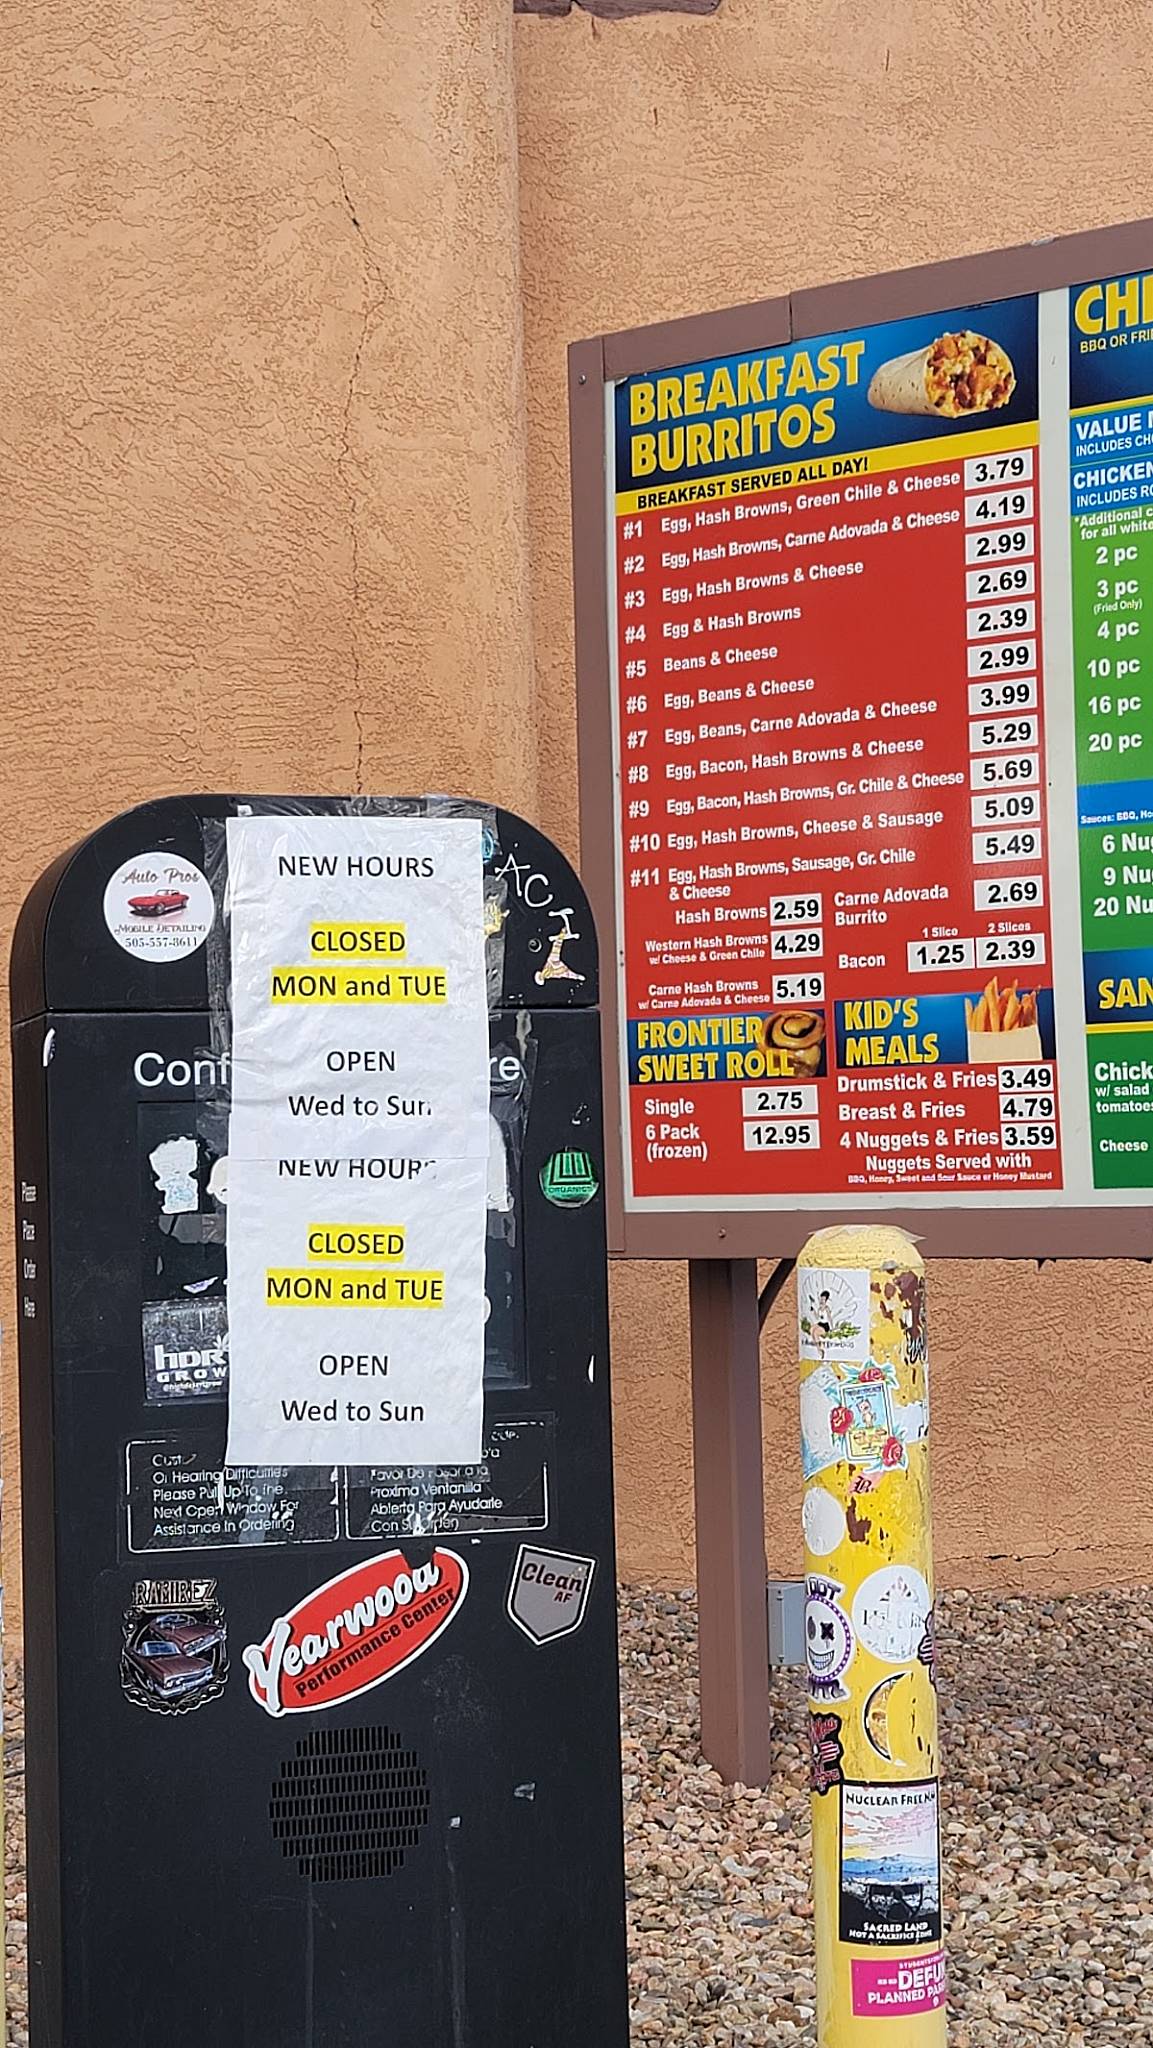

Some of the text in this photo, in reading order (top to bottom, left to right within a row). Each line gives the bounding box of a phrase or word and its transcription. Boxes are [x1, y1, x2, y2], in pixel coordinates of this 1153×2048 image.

[1080, 338, 1106, 354] BBQ
[1110, 334, 1128, 348] OR
[630, 341, 865, 426] BREAKFAST
[1076, 412, 1142, 440] VALUE
[630, 398, 836, 478] BURRITOS
[1076, 437, 1132, 457] INCLUDES
[975, 457, 1024, 482] 3.79
[637, 457, 868, 509] BREAKFAST SERVED ALL DAY!
[624, 472, 960, 540] #1 Egg, Hash Browns, Green Chile & Cheese
[976, 494, 1026, 520] 4.19
[1076, 488, 1138, 508] INCLUDES
[624, 510, 960, 575] #2 Egg, Hash Browns, Carne Adovada & Cheese
[1080, 527, 1098, 540] for
[1102, 523, 1116, 537] all
[1096, 546, 1138, 567] 2 pc
[1096, 580, 1139, 600] 3 pc
[1093, 598, 1143, 614] (Fried Only)
[982, 722, 1032, 745] 5.29
[628, 738, 924, 784] #8 Egg, Bacon, Hash Browns & Cheese
[122, 866, 200, 884] Auto Pros
[278, 855, 435, 878] NEW HOURS
[834, 885, 949, 908] Carne Adovada
[987, 882, 1038, 904] 2.69
[675, 904, 768, 924] Hash Browns
[774, 898, 820, 920] 2.59
[835, 910, 888, 927] Burrito
[310, 930, 406, 953] CLOSED
[646, 932, 768, 954] Western Hash Browns
[774, 932, 820, 954] 4.29
[985, 939, 1036, 962] 2.39
[662, 953, 698, 964] Cheese
[700, 952, 707, 961] &
[709, 949, 738, 961] Green
[740, 948, 765, 960] Chile
[838, 954, 886, 970] Bacon
[916, 944, 965, 966] 1.25
[272, 974, 446, 998] MON and TUE
[844, 998, 918, 1032] KID'S
[638, 1016, 763, 1049] FRONTIER
[326, 1050, 396, 1072] OPEN
[846, 1033, 940, 1068] MEALS
[638, 1048, 795, 1083] SWEET ROLL
[837, 1070, 997, 1094] Drumstick & Fries
[1001, 1068, 1052, 1090] 3.49
[1095, 1082, 1150, 1098] w/ salad
[288, 1094, 345, 1116] Wed
[353, 1098, 379, 1116] to
[644, 1098, 694, 1118] Single
[756, 1091, 803, 1111] 2.75
[646, 1123, 700, 1140] 6 Pack
[752, 1125, 810, 1146] 12.95
[646, 1141, 708, 1164] (frozen)
[1100, 1139, 1149, 1152] Cheese
[278, 1158, 340, 1179] NEW
[308, 1232, 404, 1256] CLOSED
[266, 1277, 443, 1300] MON and TUE
[156, 1368, 228, 1383] GROW
[318, 1354, 389, 1376] OPEN
[281, 1400, 424, 1422] Wed to Sun
[522, 1562, 582, 1592] Clean
[135, 1579, 217, 1604] RAMIREZ
[554, 1592, 572, 1603] AF
[295, 1587, 455, 1698] Performance Center
[846, 1792, 899, 1807] NUCLEAR
[864, 1922, 928, 1933] SACRED LAND
[867, 1990, 926, 2004] PLANNED
